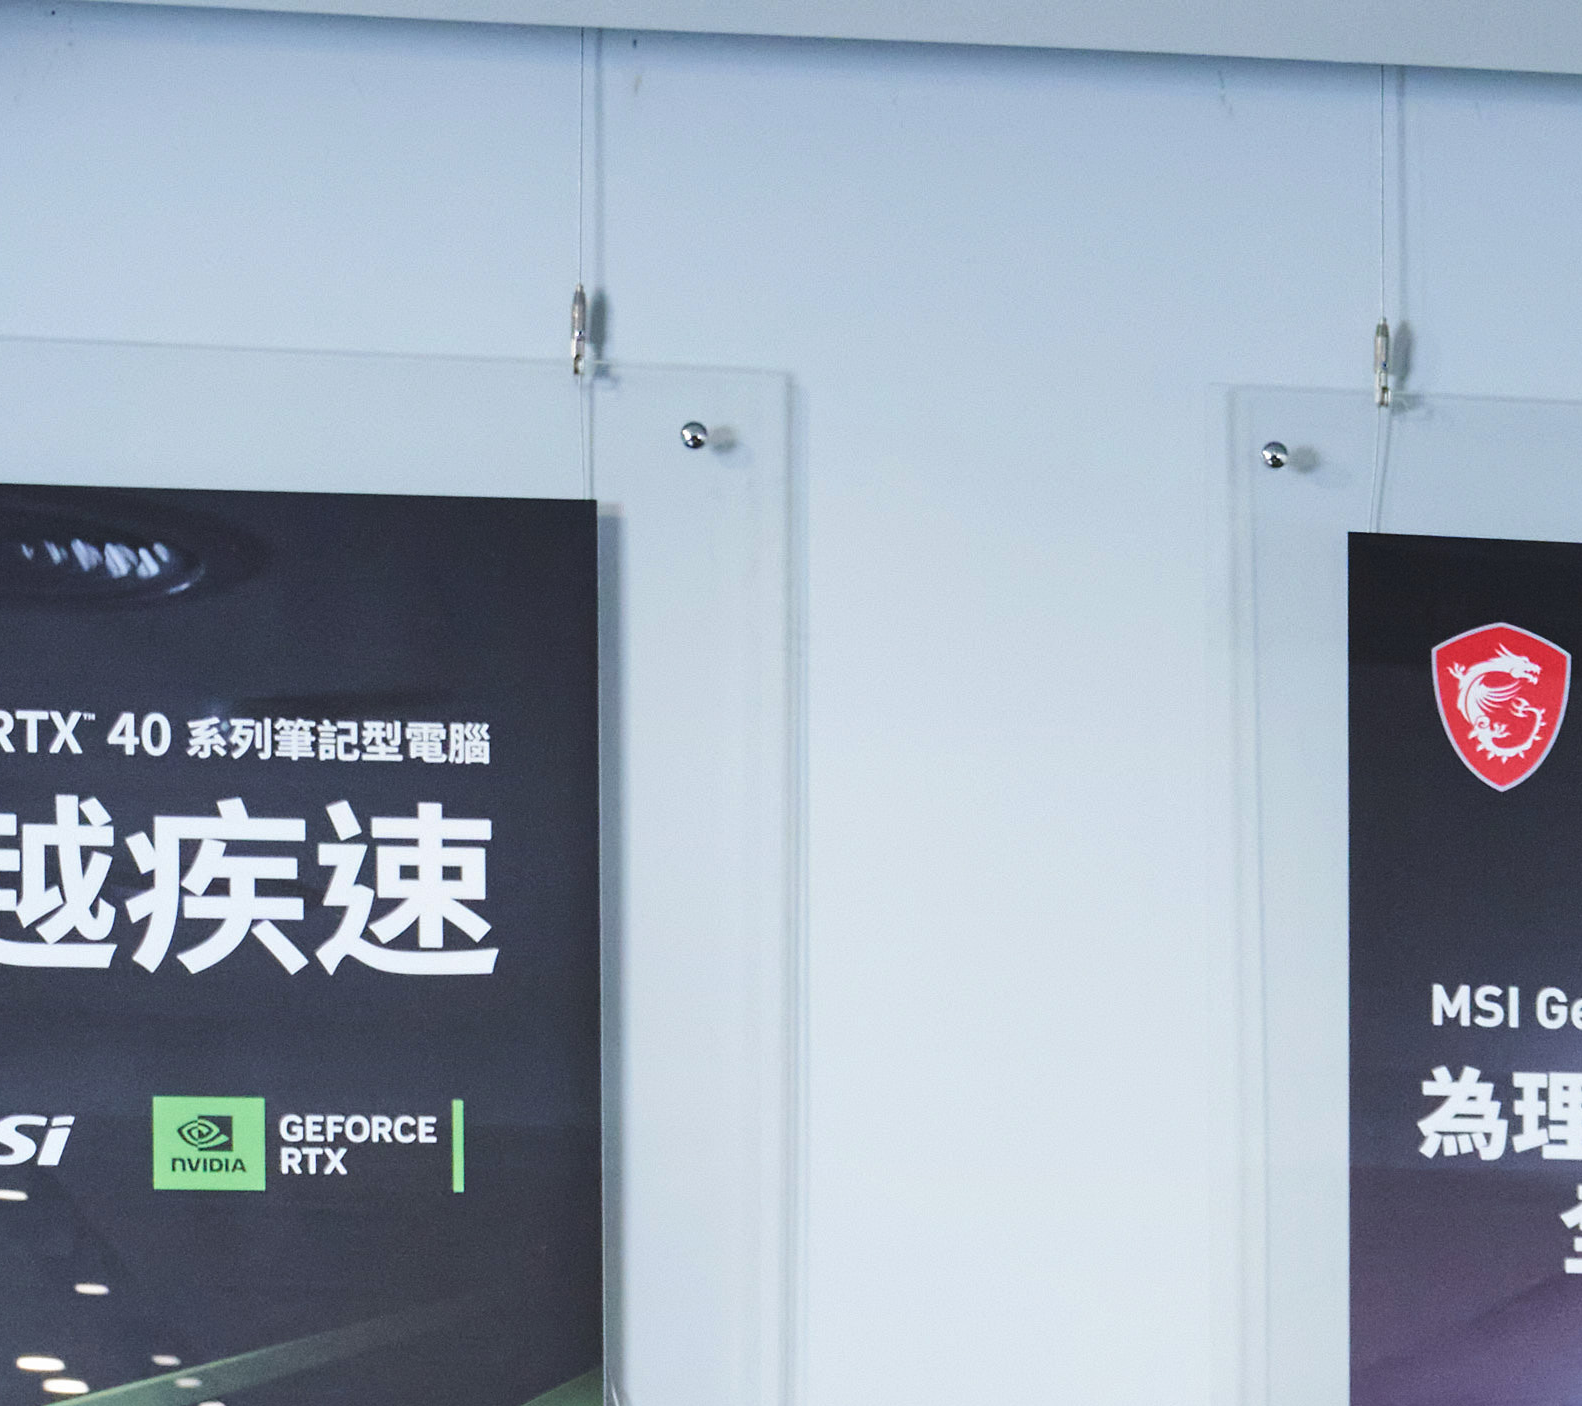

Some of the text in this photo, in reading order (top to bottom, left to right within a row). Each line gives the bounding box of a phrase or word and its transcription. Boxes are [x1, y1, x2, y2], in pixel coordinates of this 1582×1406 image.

[106, 711, 172, 757] 40
[186, 715, 492, 765] 系列筆記型電腦
[1431, 983, 1521, 1030] MSI
[279, 1112, 439, 1146] GEFORCE
[170, 1156, 247, 1174] NVIDIA
[279, 1145, 349, 1176] RTX
